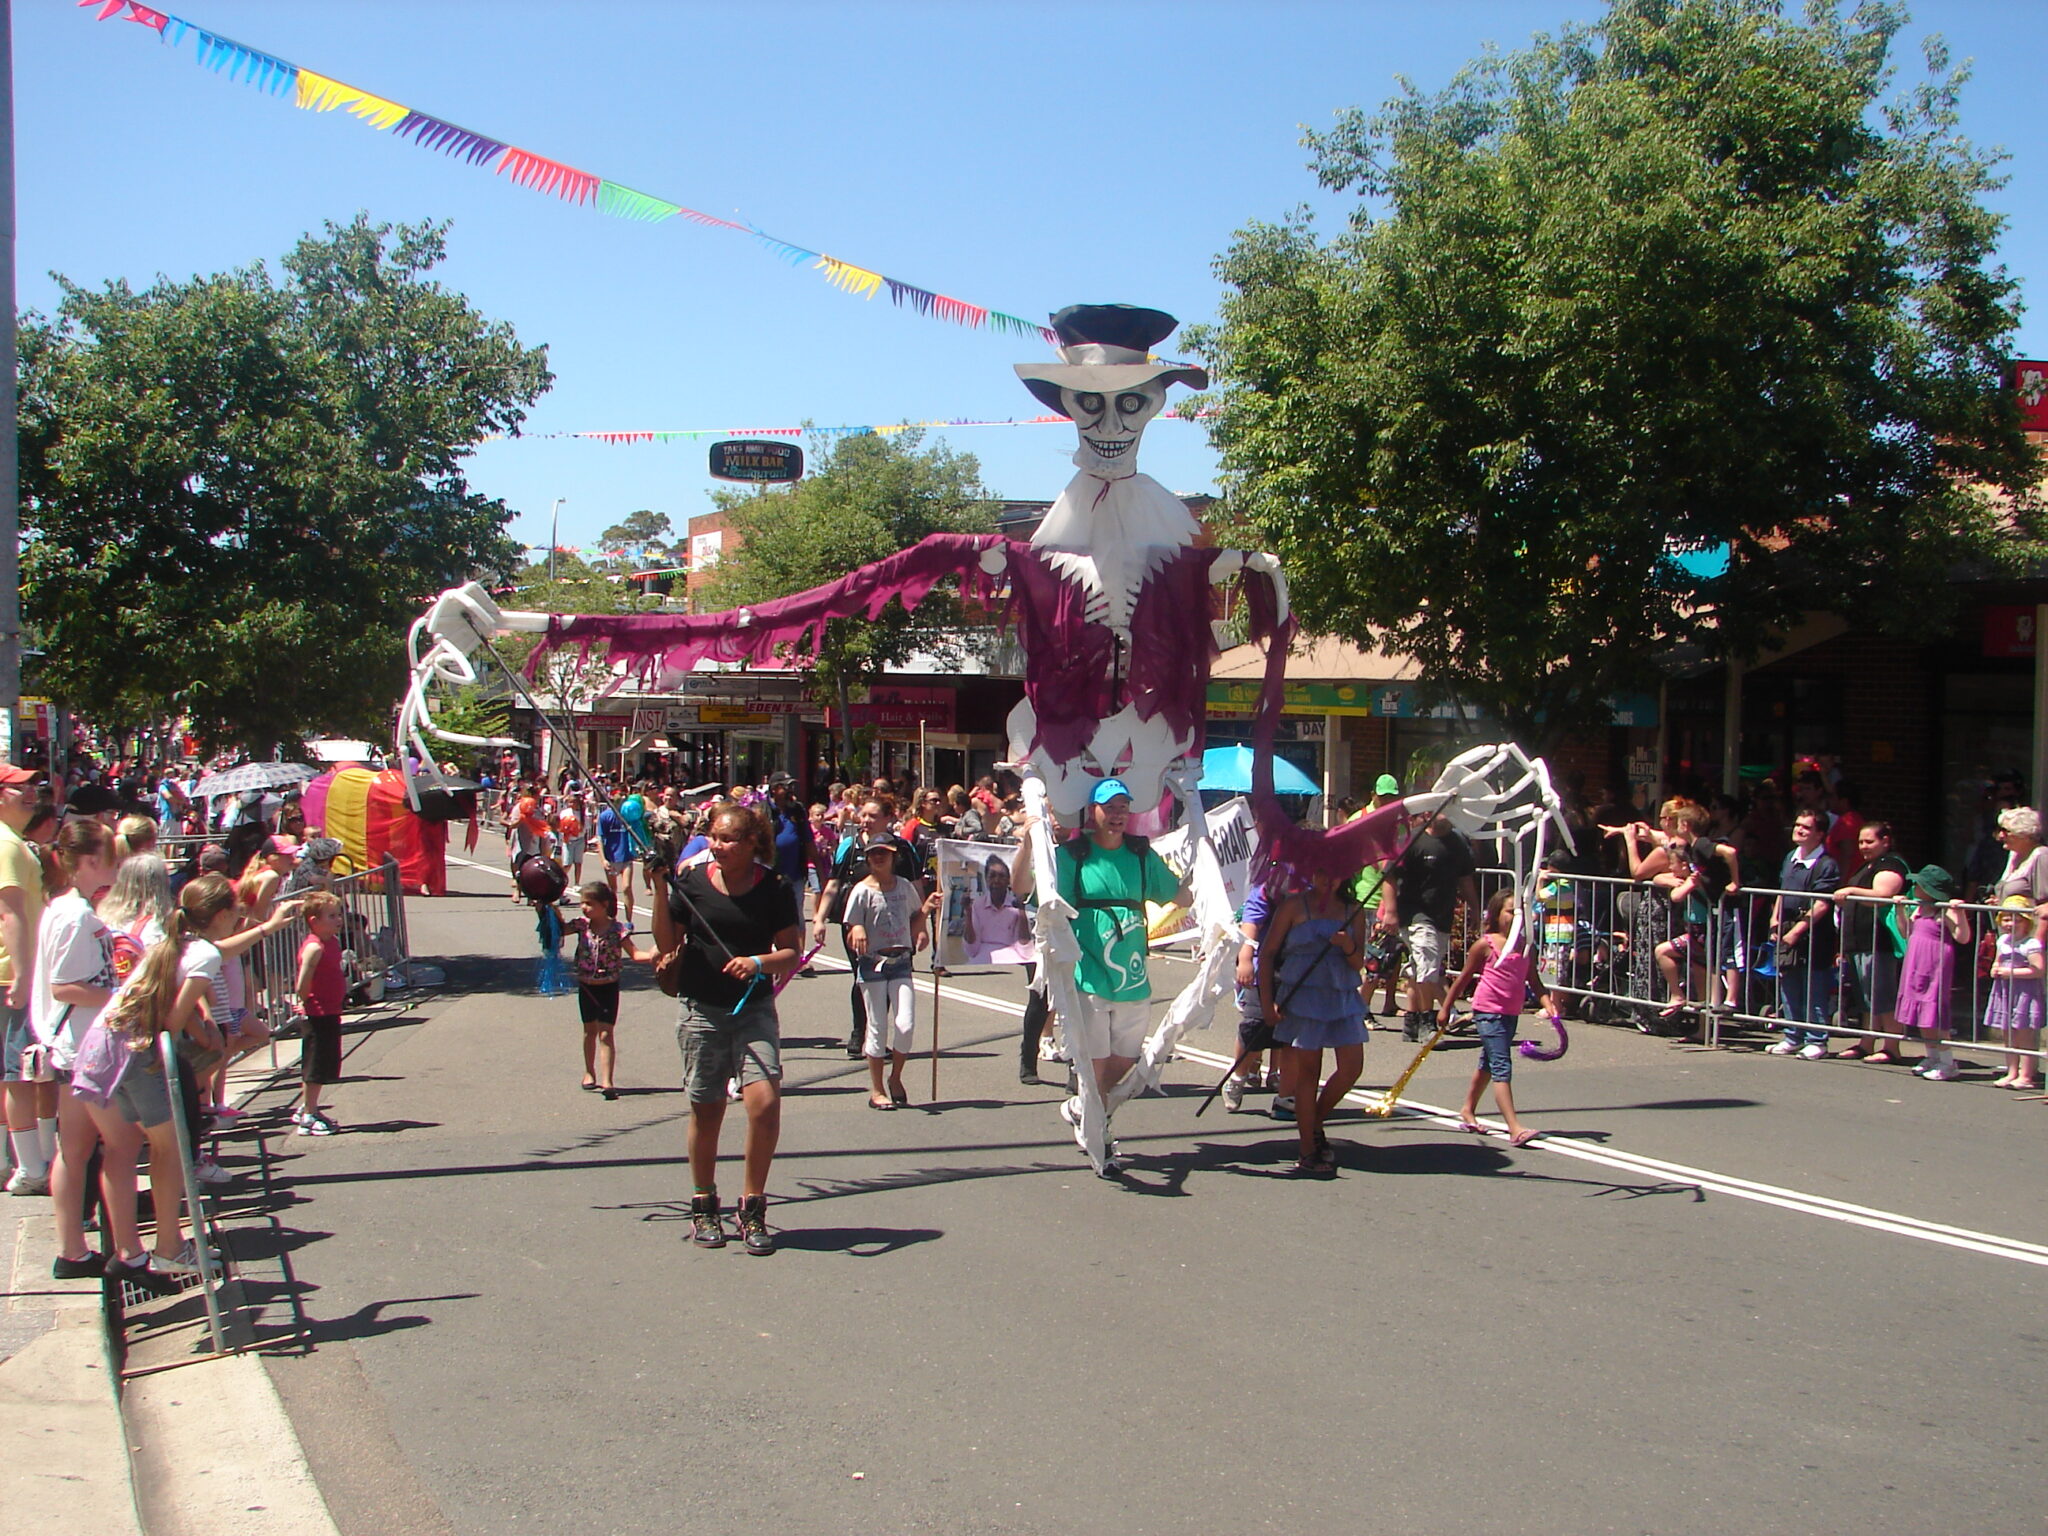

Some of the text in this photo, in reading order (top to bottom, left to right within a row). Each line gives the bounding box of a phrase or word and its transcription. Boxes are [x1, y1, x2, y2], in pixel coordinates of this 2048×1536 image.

[725, 456, 785, 467] MILK BAR
[749, 702, 793, 713] EDEN'S
[881, 711, 903, 722] Hair
